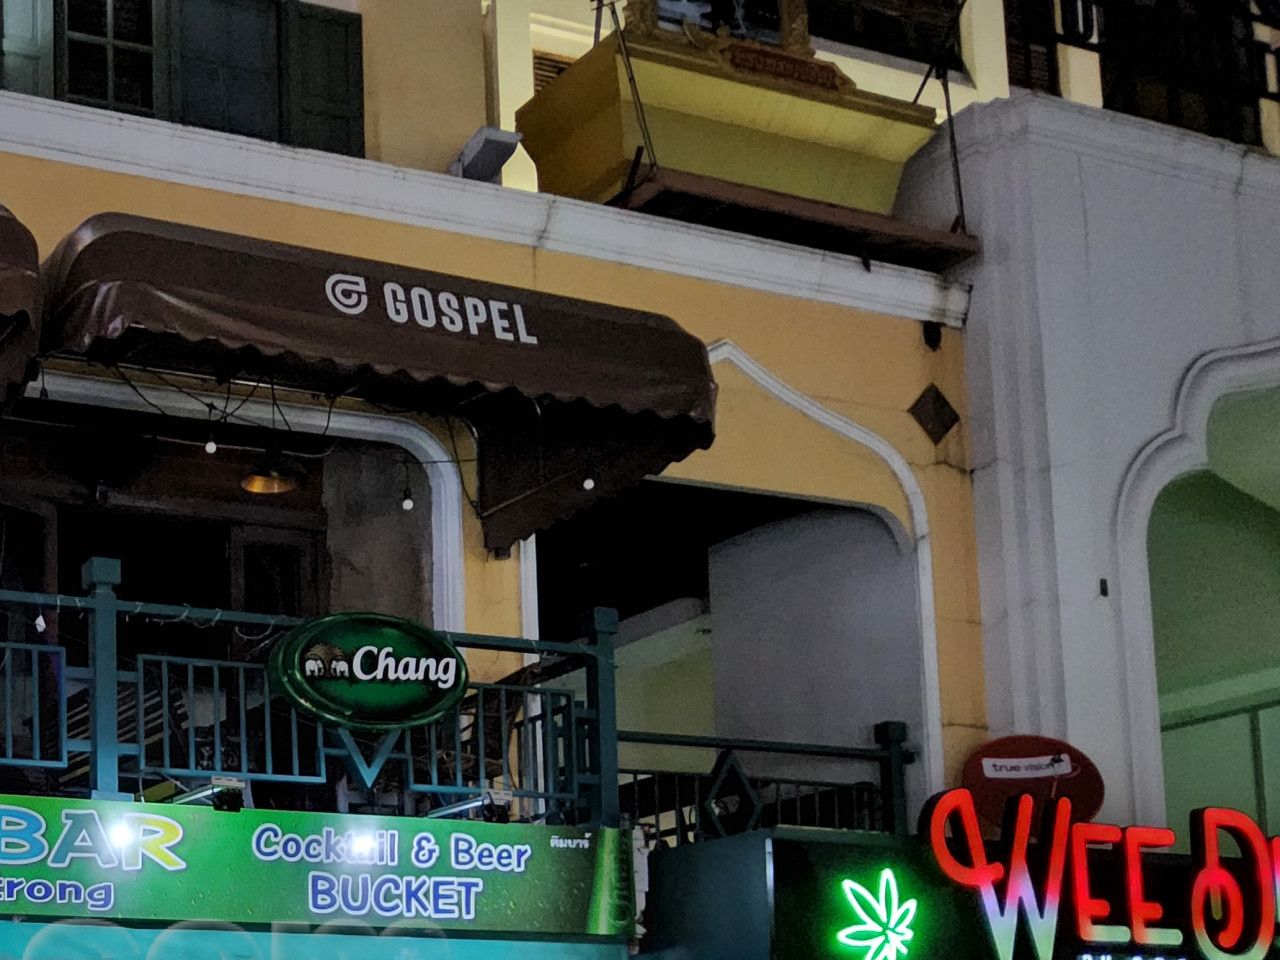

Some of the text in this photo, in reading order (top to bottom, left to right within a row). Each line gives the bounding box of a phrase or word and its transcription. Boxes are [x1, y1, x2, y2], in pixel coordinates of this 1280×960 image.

[383, 281, 538, 345] GOSPEL
[351, 645, 457, 689] Chang
[411, 832, 439, 868] &
[451, 834, 531, 872] Beer
[308, 870, 483, 920] BUCKET
